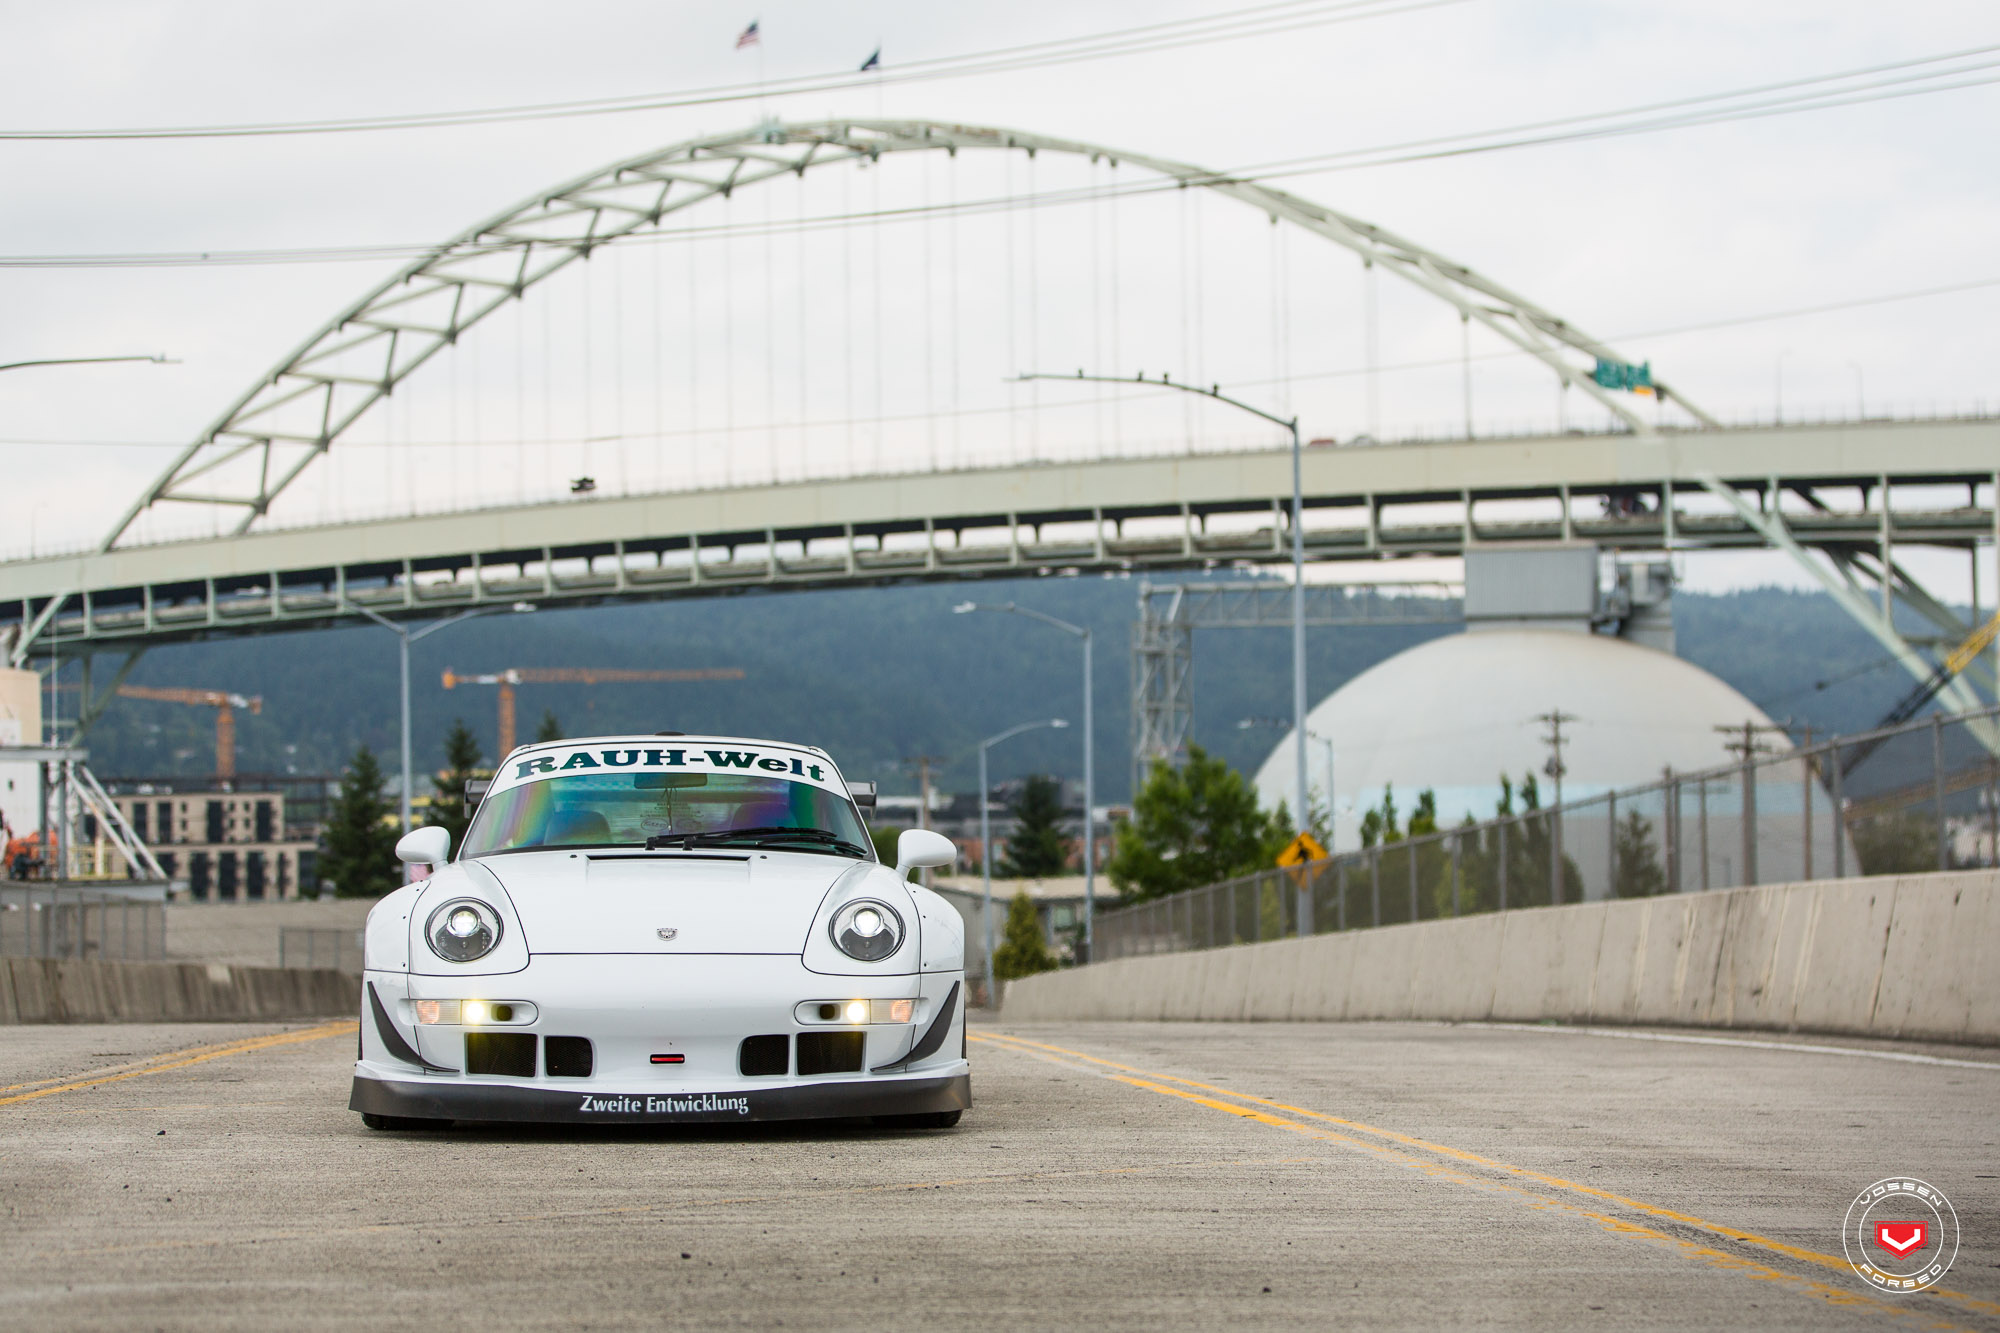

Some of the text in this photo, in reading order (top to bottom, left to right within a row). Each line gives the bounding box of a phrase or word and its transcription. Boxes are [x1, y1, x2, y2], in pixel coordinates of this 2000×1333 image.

[515, 750, 825, 781] RAUH-Welt
[580, 1094, 748, 1114] Zweite Entwicklung
